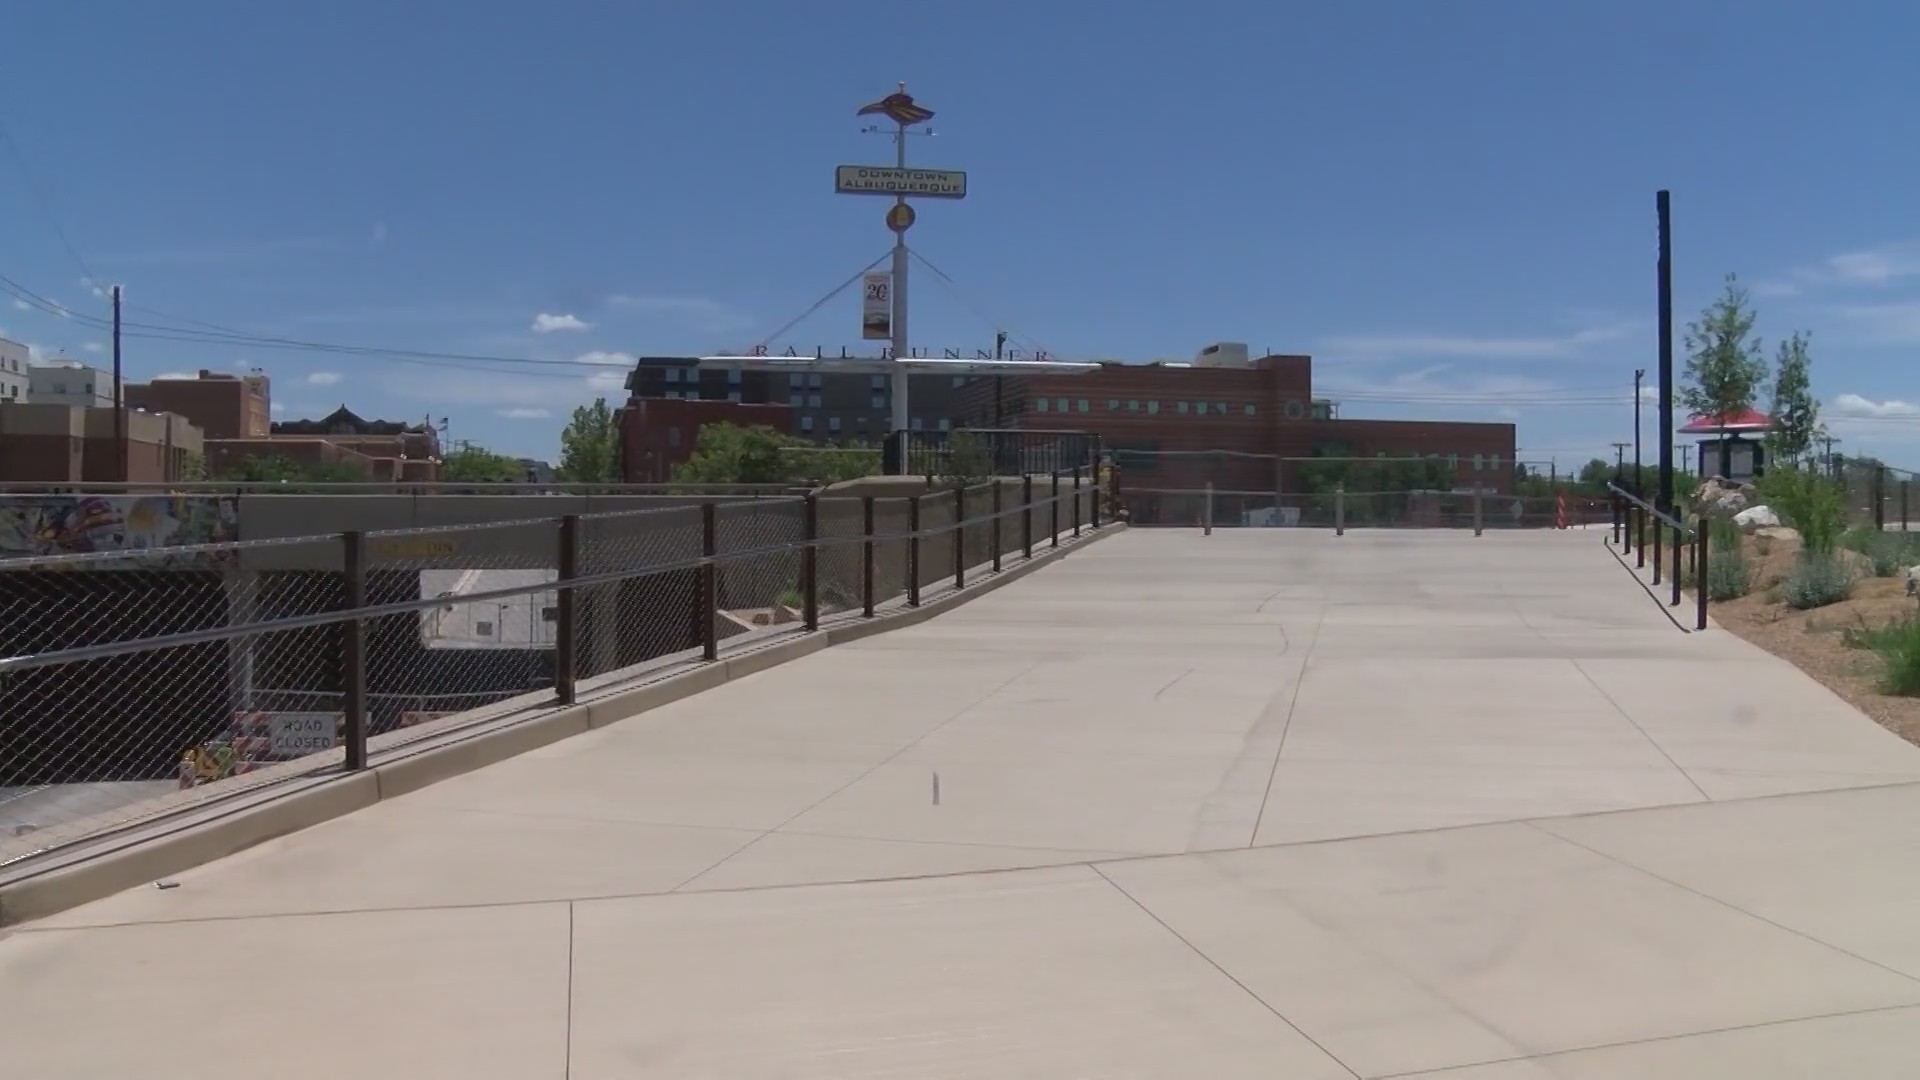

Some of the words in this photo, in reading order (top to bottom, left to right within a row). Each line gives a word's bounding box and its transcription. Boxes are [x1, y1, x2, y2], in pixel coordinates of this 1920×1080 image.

[858, 169, 948, 182] DOWNTOWN
[844, 179, 960, 193] ALBUQUERQUE
[755, 345, 855, 360] RAIL
[881, 347, 1048, 362] RUNNER
[284, 719, 323, 731] ROAD
[276, 737, 330, 748] CLOSED
